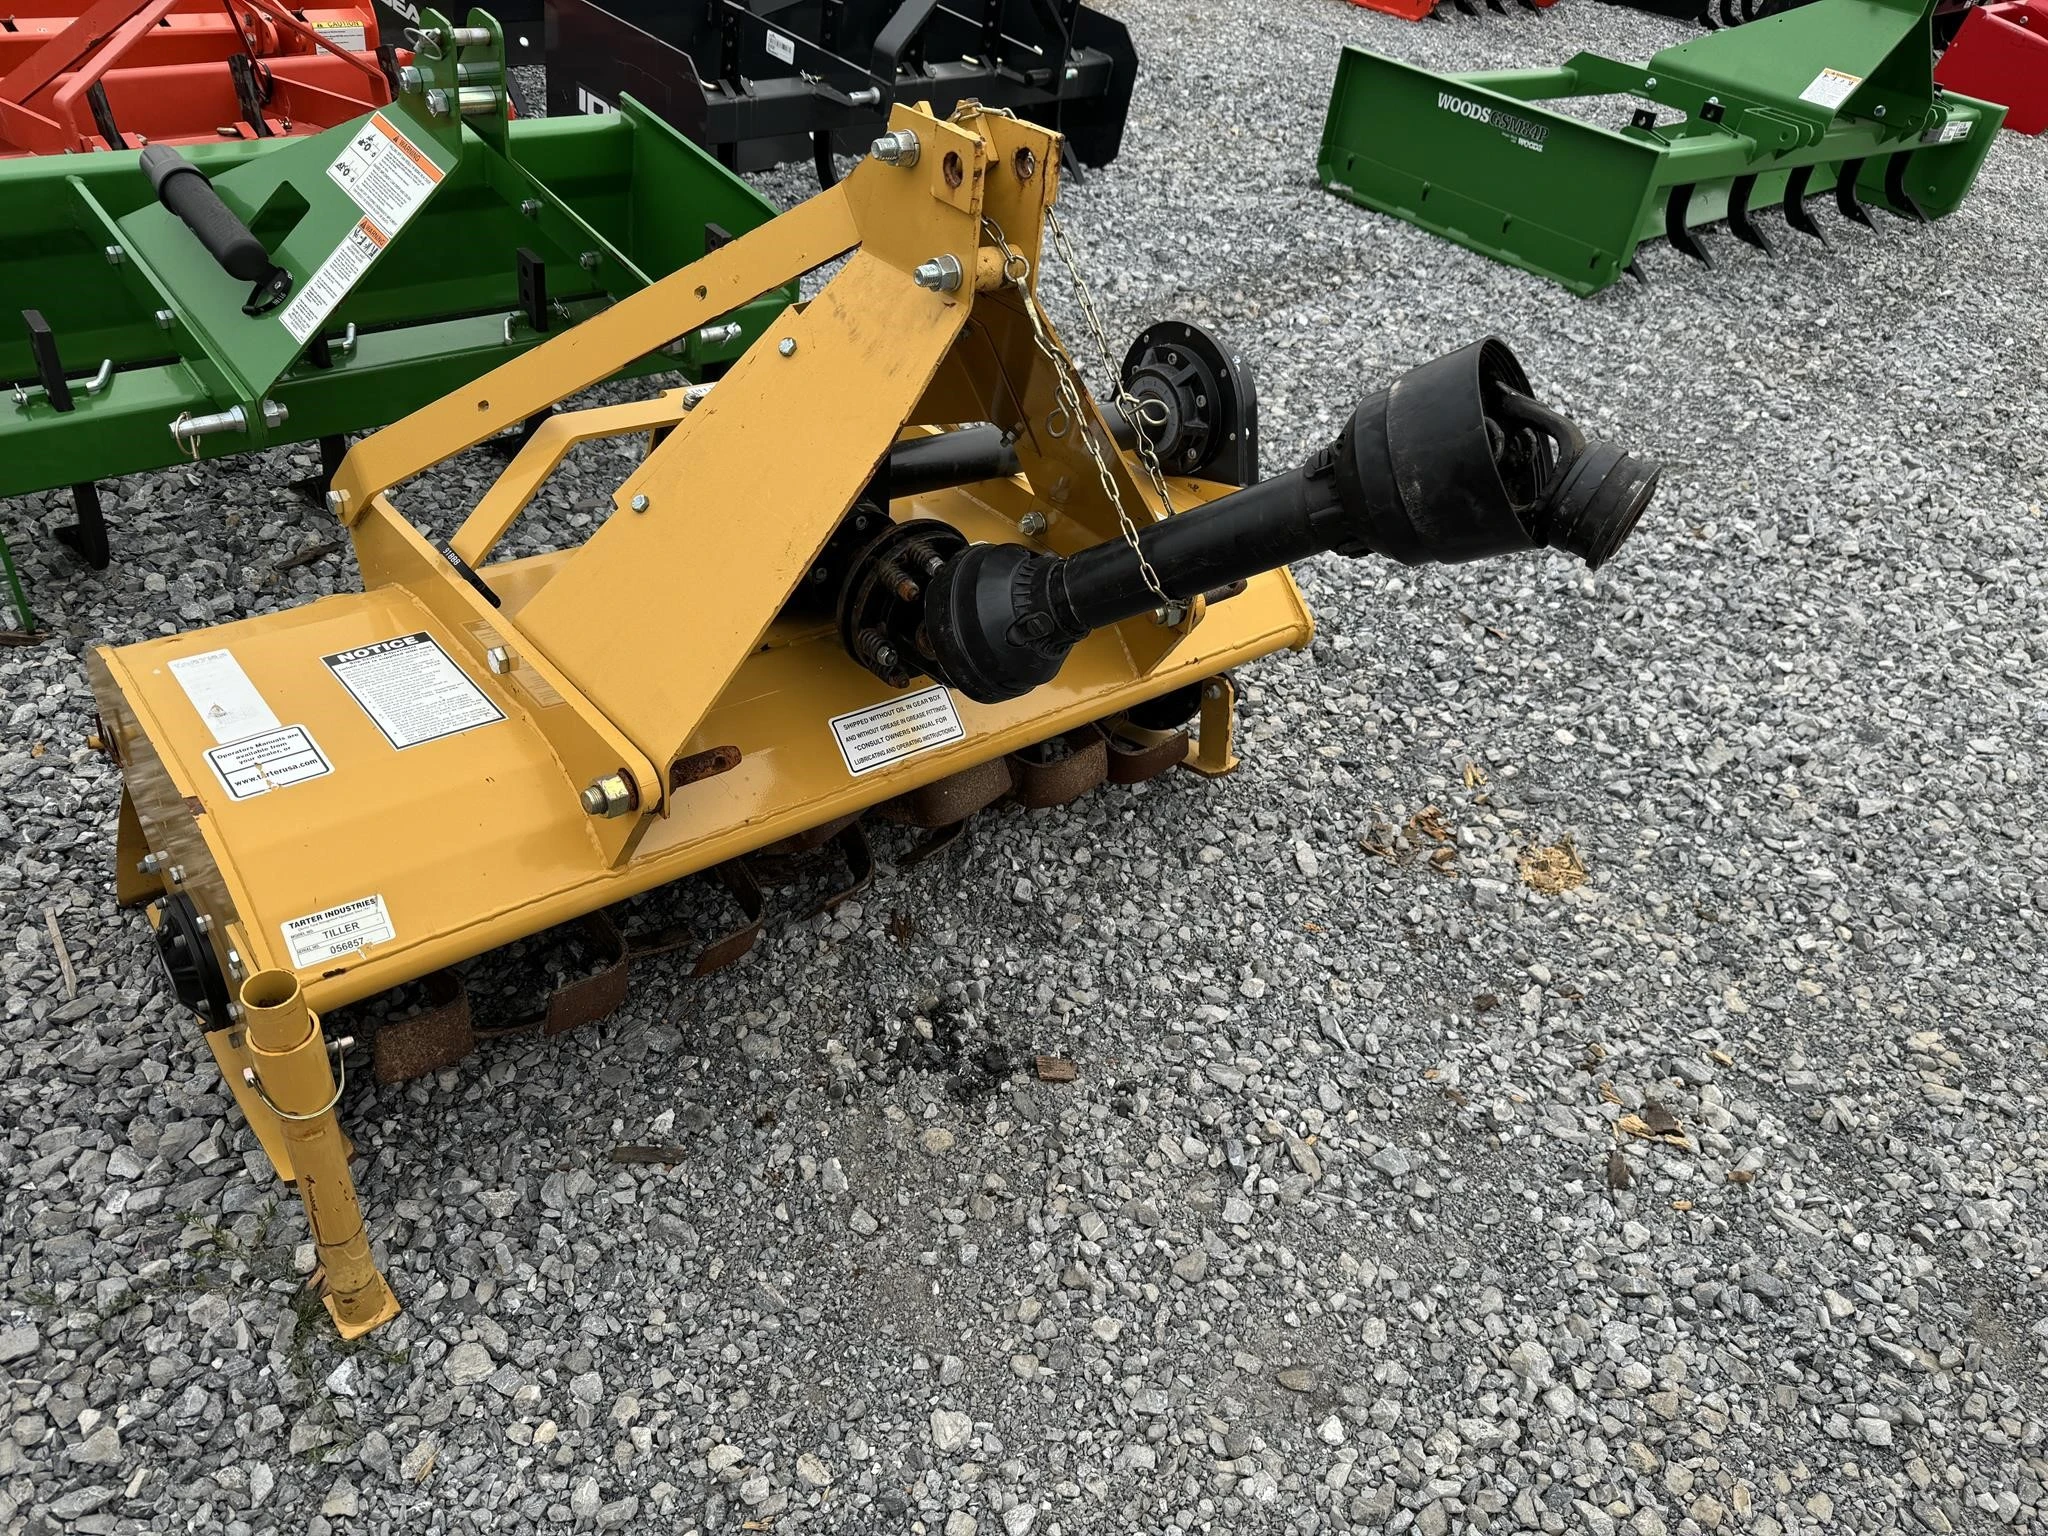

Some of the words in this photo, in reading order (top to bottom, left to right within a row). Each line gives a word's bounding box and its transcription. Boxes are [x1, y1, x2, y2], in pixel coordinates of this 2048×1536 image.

[381, 0, 420, 25] EA
[579, 87, 621, 115] ID
[1437, 92, 1491, 123] WOODS
[1488, 110, 1550, 142] GSM84P
[399, 140, 421, 162] WARNING
[366, 221, 385, 246] WARNING
[442, 547, 461, 566] 91888
[337, 636, 419, 663] NOTICE
[842, 717, 869, 730] SHIPPED
[868, 709, 895, 721] WITHOUT
[895, 705, 906, 713] OIL
[911, 698, 929, 707] GEAR
[928, 694, 941, 702] BOX
[844, 734, 857, 742] AND
[856, 726, 879, 738] WITHOUT
[879, 720, 900, 731] GREASE
[905, 711, 926, 722] GREASE
[884, 728, 910, 741] OWNERS
[910, 720, 934, 732] MANUAL
[934, 715, 947, 724] FOR
[216, 745, 254, 759] Operators
[254, 735, 285, 747] Manuals
[234, 747, 269, 759] available
[269, 741, 287, 749] from
[238, 756, 256, 764] your
[256, 748, 282, 759] dealer,
[853, 750, 886, 765] LUBRICATING
[885, 746, 896, 754] AND
[895, 737, 922, 750] OPERATING
[288, 914, 323, 929] TARTER
[324, 898, 376, 918] INDUSTRIES
[322, 921, 360, 939] TILLER
[330, 936, 364, 954] 056857
